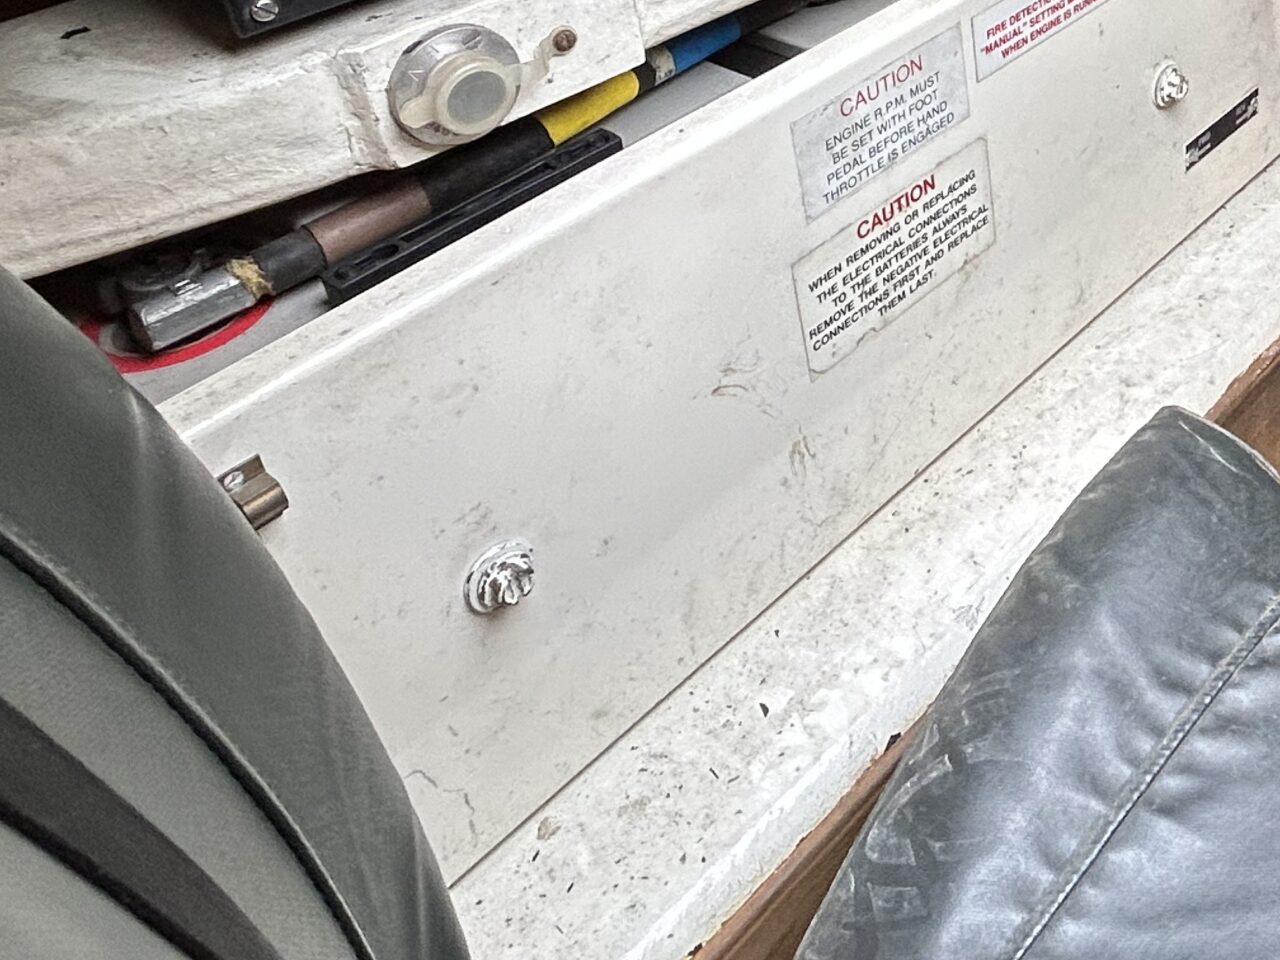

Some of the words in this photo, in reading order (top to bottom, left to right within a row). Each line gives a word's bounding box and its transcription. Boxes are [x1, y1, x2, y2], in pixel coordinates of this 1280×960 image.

[986, 19, 1008, 40] FIRE
[1001, 36, 1029, 59] WHEN
[1030, 15, 1063, 42] ENGINE
[1063, 9, 1072, 22] IS
[825, 113, 872, 153] ENGINE
[909, 71, 941, 98] MUST
[832, 147, 849, 166] BE
[851, 129, 875, 153] SET
[876, 108, 907, 138] WITH
[908, 89, 940, 118] FOOT
[839, 54, 924, 118] CAUTION
[823, 157, 887, 205] THROTTLE
[888, 148, 899, 163] IS
[901, 111, 955, 154] ENGAGED
[826, 154, 865, 186] PEDAL
[868, 123, 916, 159] BEFORE
[917, 100, 949, 128] HAND
[808, 263, 843, 293] WHEN
[845, 224, 901, 268] REMOVING
[904, 209, 919, 226] OR
[922, 169, 977, 213] REPLACING
[816, 282, 839, 305] THE
[842, 238, 905, 287] ELECTRICAL
[908, 183, 978, 237] CONNECTIONS
[856, 175, 936, 240] CAUTION
[809, 300, 855, 340] REMOVE
[857, 280, 880, 303] THE
[882, 245, 931, 287] NEGATIVE
[932, 203, 990, 249] ELECTRICAL
[813, 289, 890, 353] CONNECTIONS
[893, 266, 921, 294] FIRST
[924, 250, 945, 270] AND
[947, 215, 990, 253] REPLACE
[832, 291, 847, 308] TO
[850, 273, 873, 297] THE
[875, 233, 928, 277] BATTERIES
[932, 205, 969, 236] ALWAYS
[878, 291, 908, 318] THEM
